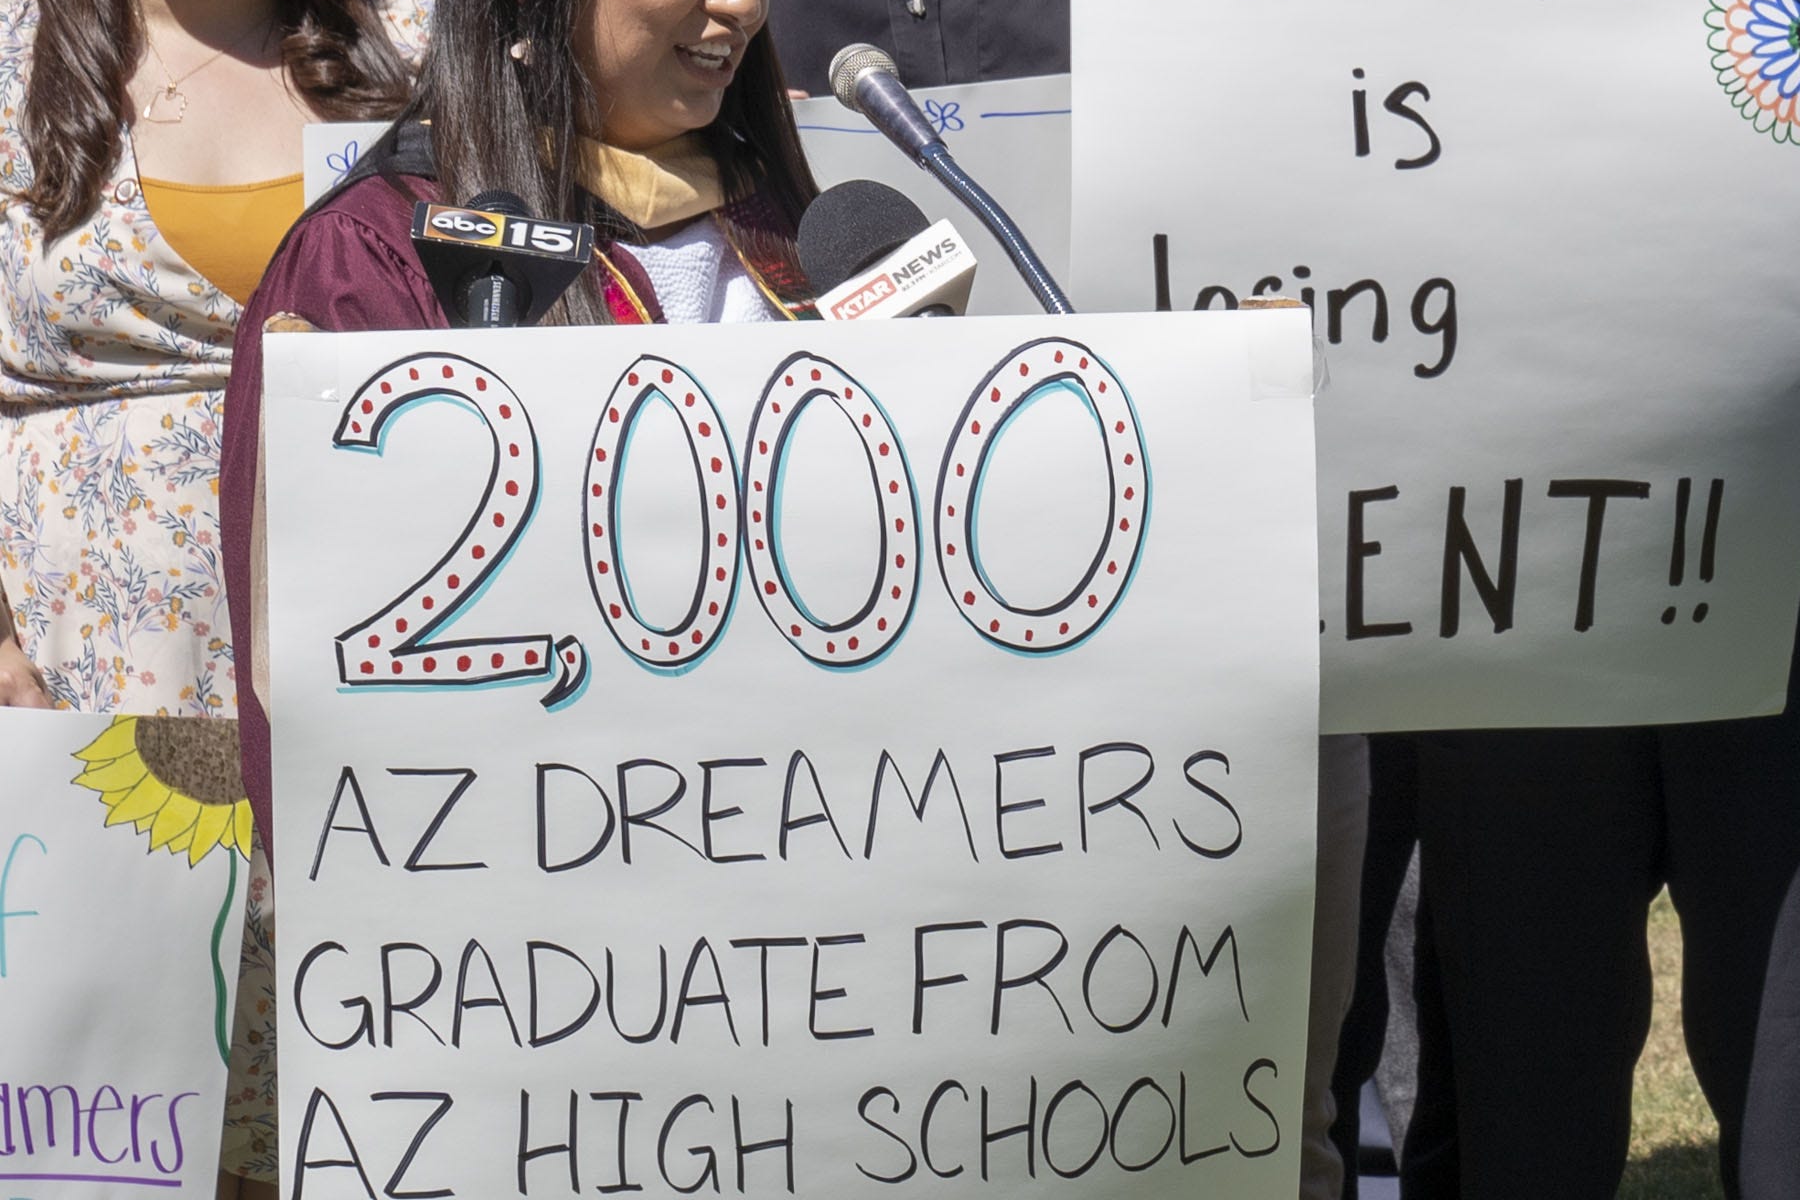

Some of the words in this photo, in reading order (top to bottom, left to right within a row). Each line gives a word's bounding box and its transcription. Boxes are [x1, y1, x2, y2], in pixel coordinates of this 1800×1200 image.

[1352, 68, 1442, 171] is
[431, 215, 497, 236] abc
[509, 221, 574, 253] 15
[837, 279, 892, 320] KTAR
[891, 237, 957, 285] NEWS
[333, 336, 1153, 713] 2,000
[1320, 477, 1726, 641] ENT!!
[309, 764, 489, 882] AZ
[535, 741, 1244, 874] DREAMERS
[293, 932, 875, 1050] GRADUATE
[913, 918, 1250, 1037] FROM
[291, 1086, 456, 1200] AZ
[517, 1088, 796, 1197] HIGH
[855, 1057, 1282, 1187] SCHOOLS
